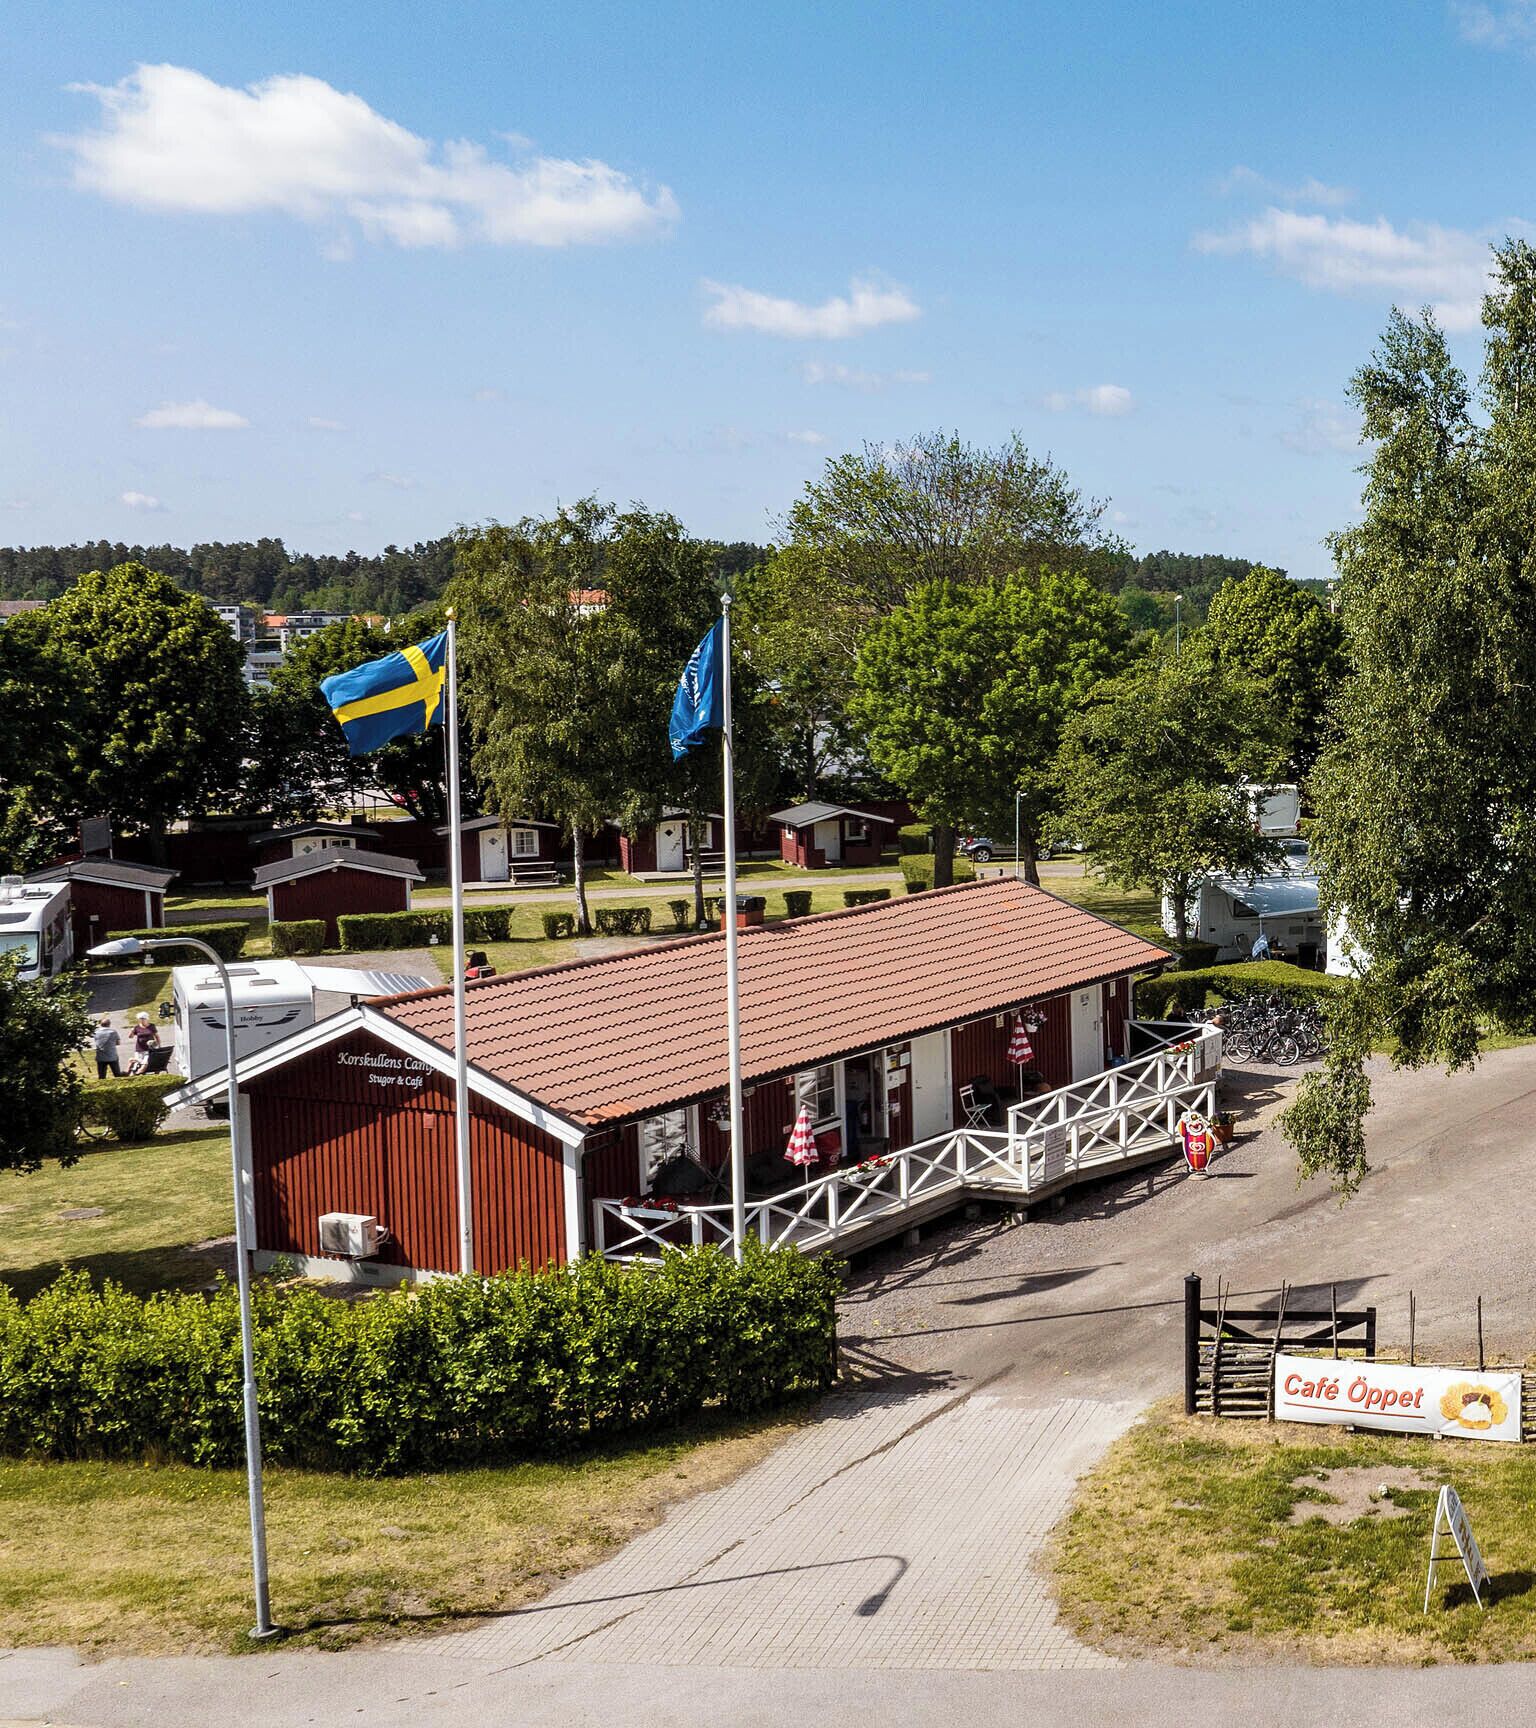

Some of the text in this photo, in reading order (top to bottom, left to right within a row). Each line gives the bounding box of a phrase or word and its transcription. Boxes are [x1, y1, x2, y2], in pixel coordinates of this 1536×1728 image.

[240, 1015, 264, 1023] Hobby
[337, 1052, 439, 1076] Korskullens Camp
[368, 1073, 424, 1089] Stugor & Café
[1284, 1373, 1425, 1411] Café Öppet
